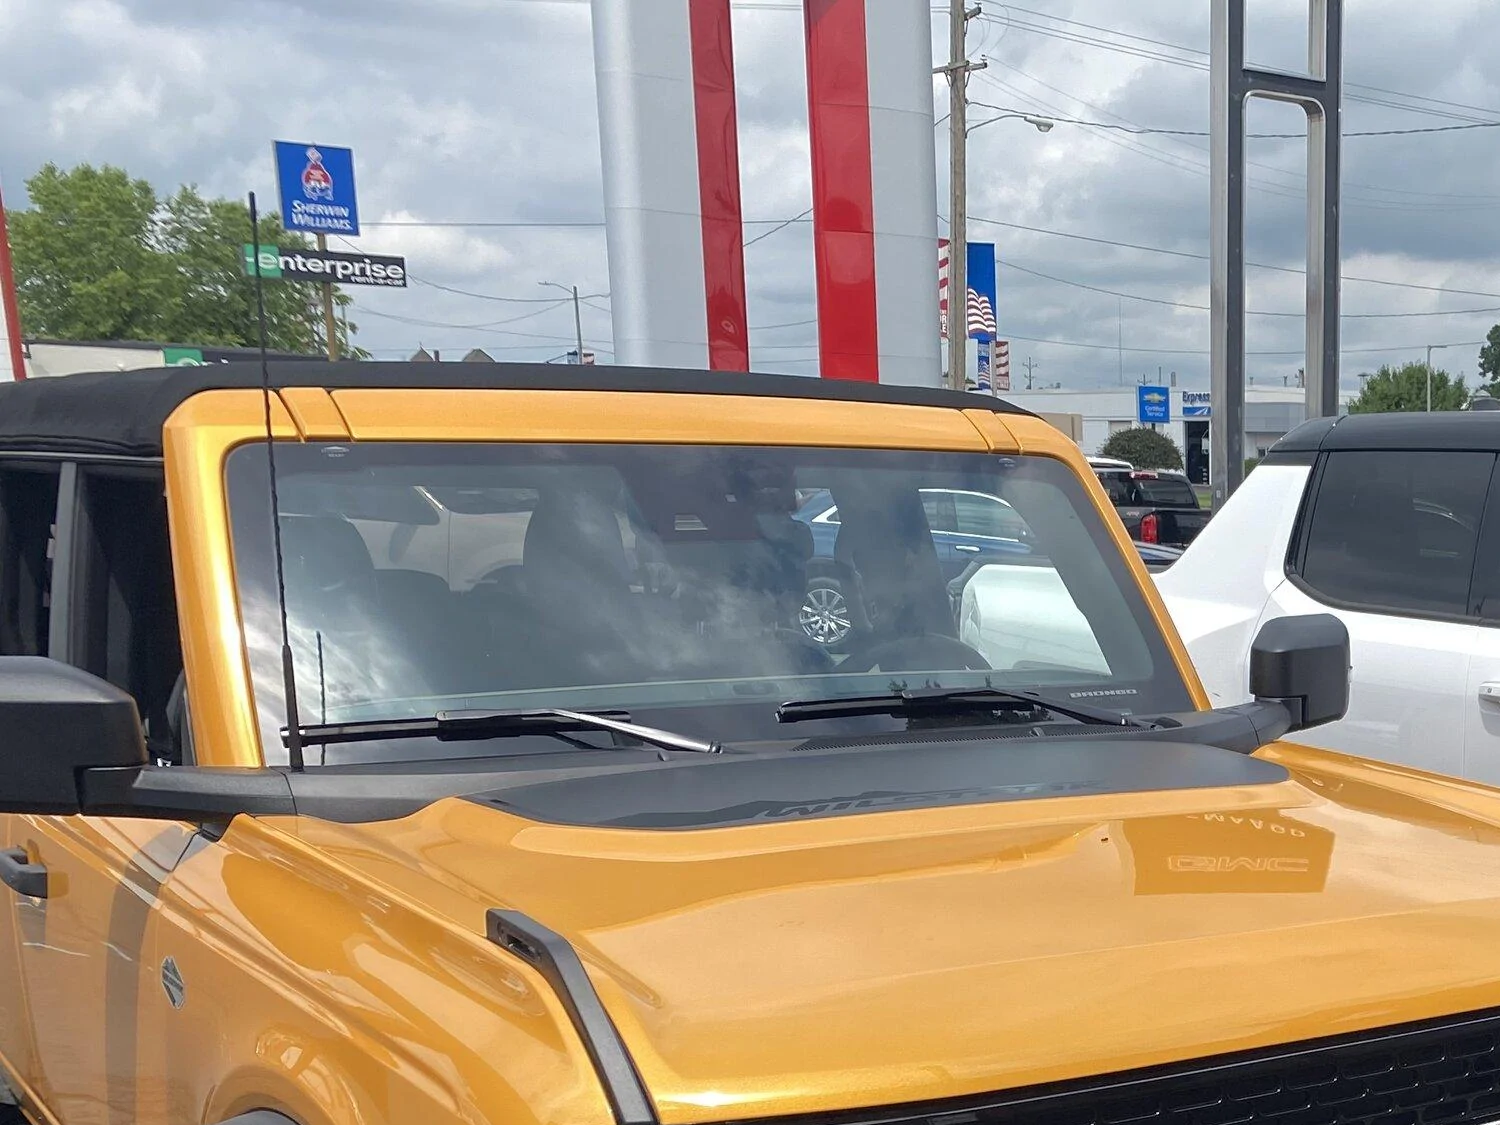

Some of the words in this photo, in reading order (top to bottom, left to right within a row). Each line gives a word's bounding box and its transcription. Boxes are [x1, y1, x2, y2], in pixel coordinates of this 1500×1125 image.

[291, 199, 350, 218] SHERWIN
[257, 252, 405, 280] enterprise
[350, 274, 405, 286] rent-a-car
